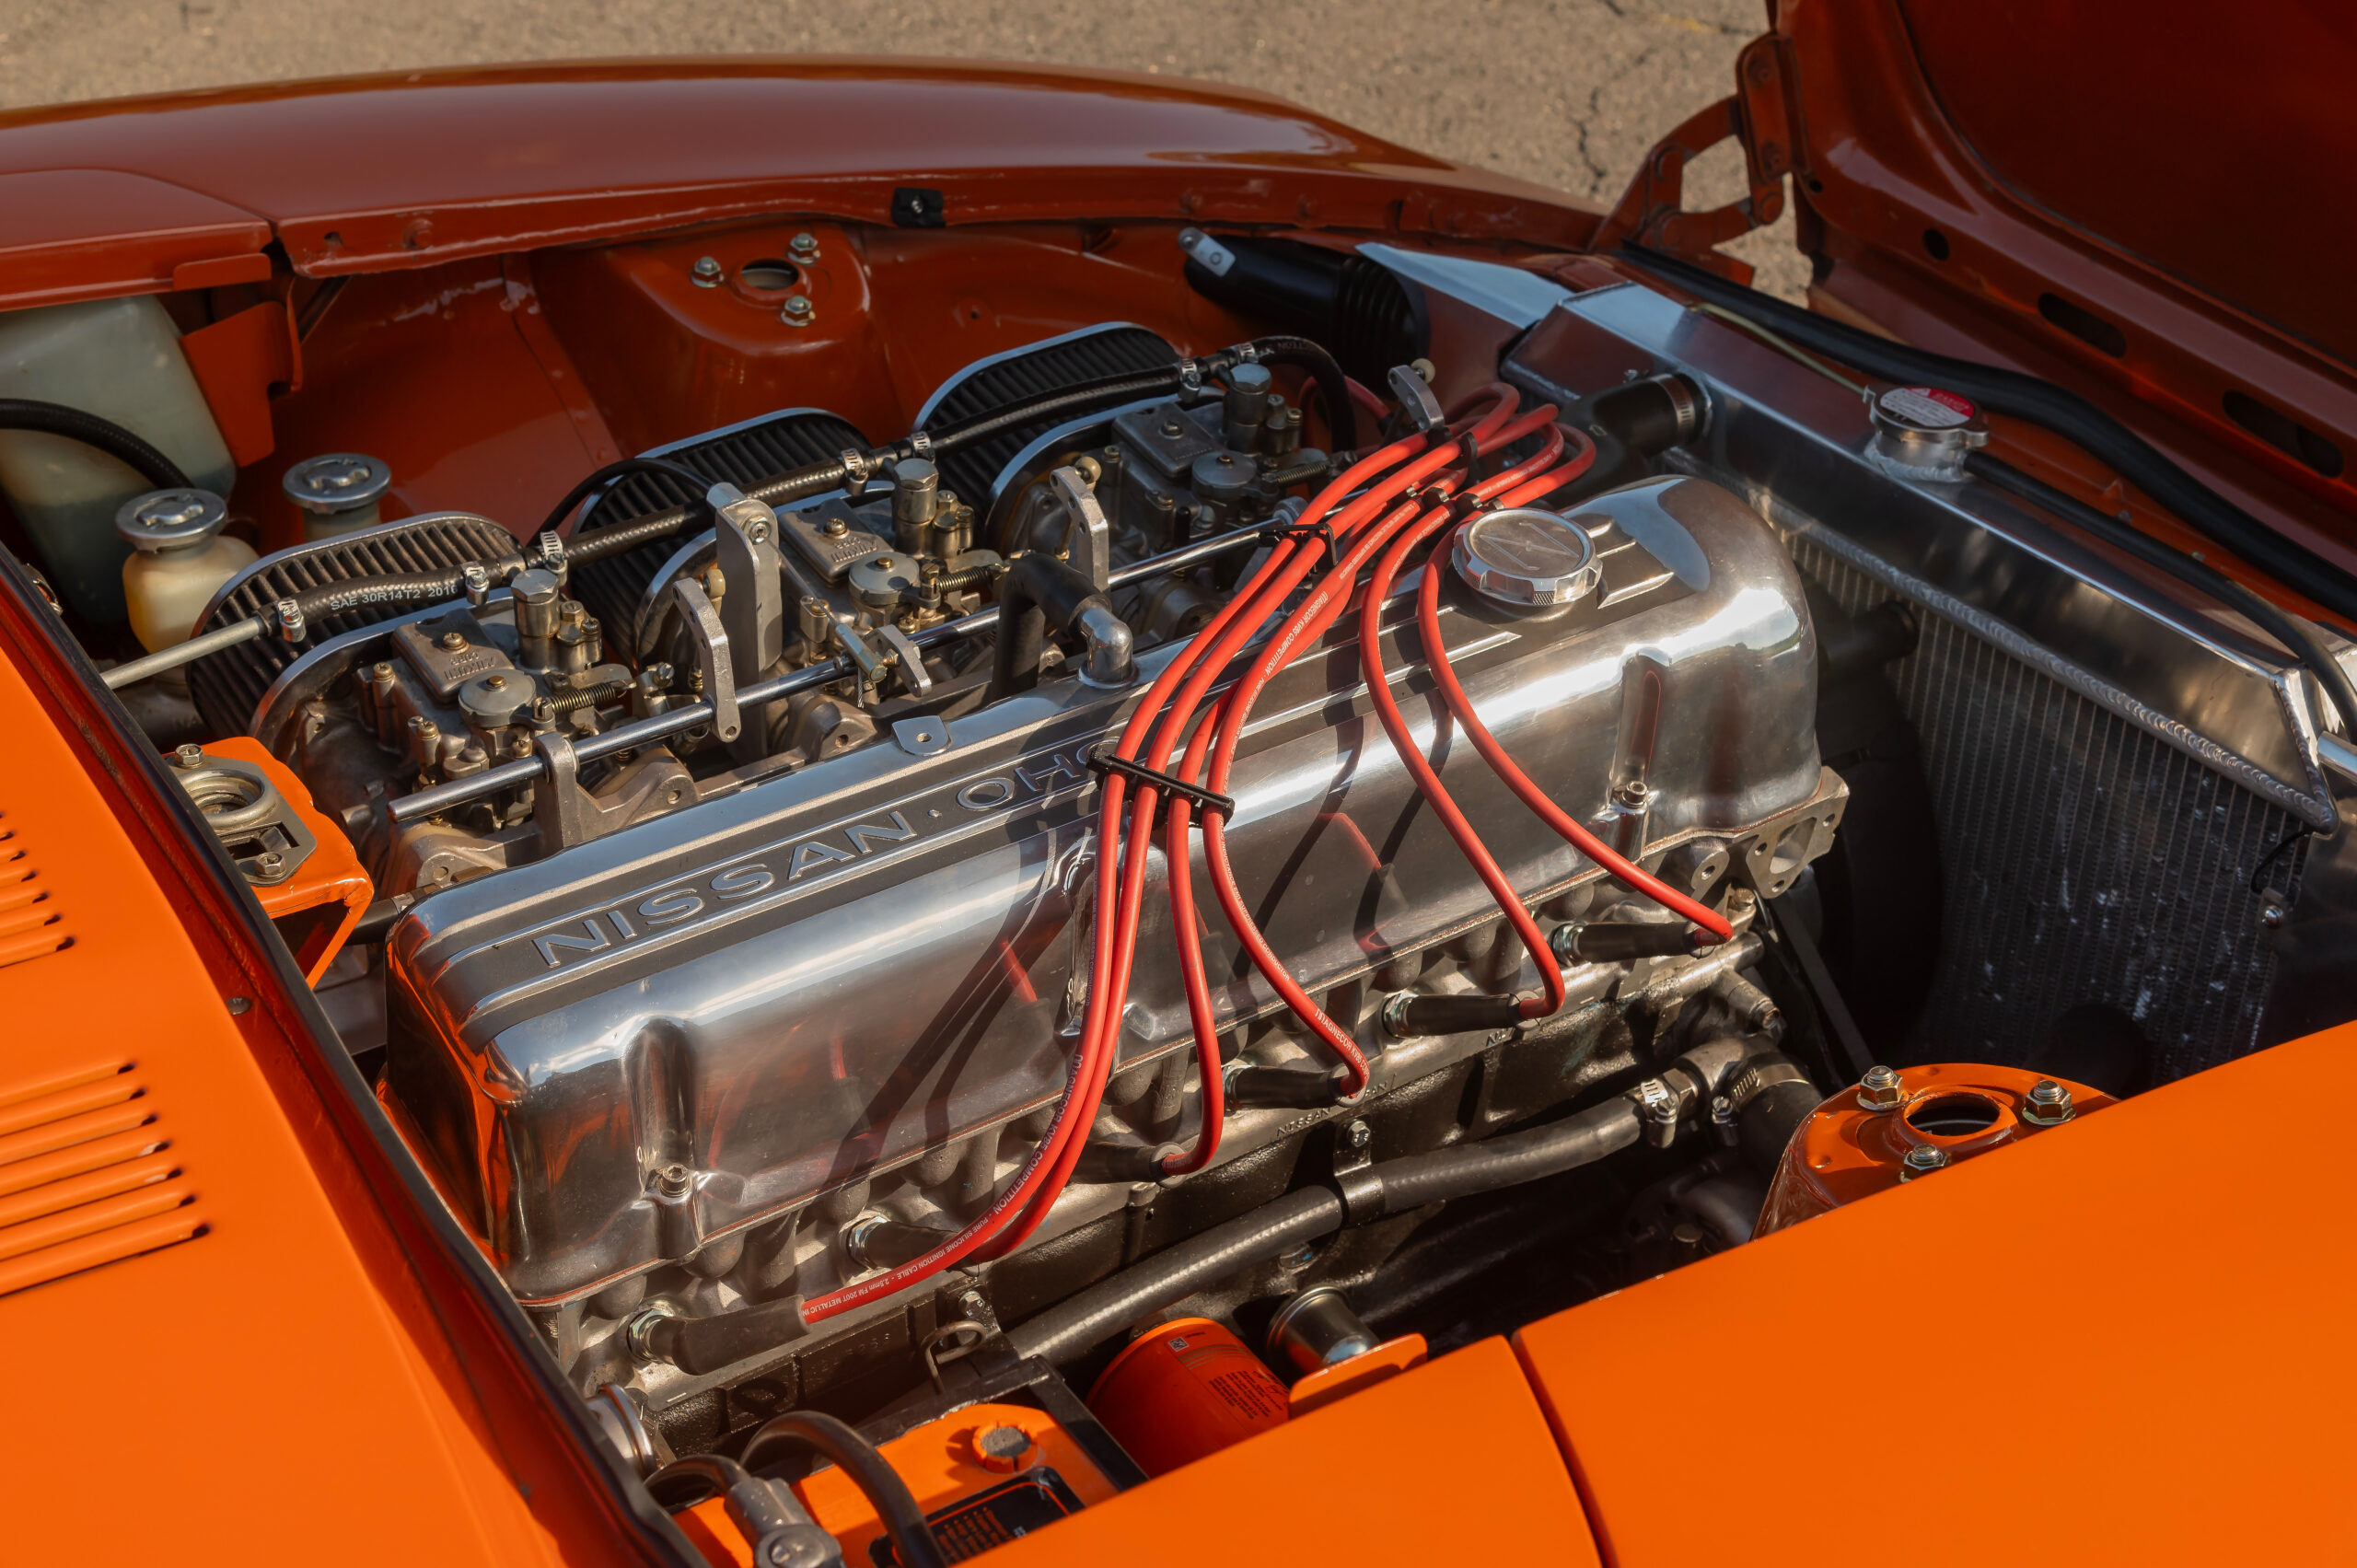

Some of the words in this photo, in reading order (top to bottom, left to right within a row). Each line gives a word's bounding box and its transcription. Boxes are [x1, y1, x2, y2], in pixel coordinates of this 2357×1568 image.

[330, 596, 358, 610] SAE
[362, 588, 421, 604] 30R14T2
[427, 584, 458, 598] 2016
[1264, 633, 1295, 676] COMPETITION
[532, 809, 917, 967] NISSAN
[1262, 943, 1290, 981] CONDUCTOR
[1314, 1008, 1353, 1051] MAGNECOR
[1053, 1053, 1084, 1123] MAGNECOR
[1039, 1123, 1059, 1151] KV85
[992, 1150, 1043, 1215] COMPETITION
[971, 1216, 989, 1233] PURE
[945, 1230, 973, 1253] SILICONE
[896, 1264, 919, 1280] CABLE
[918, 1248, 946, 1270] IGNITION
[868, 1278, 889, 1291] 2.5mm
[809, 1296, 842, 1314] METALLIC
